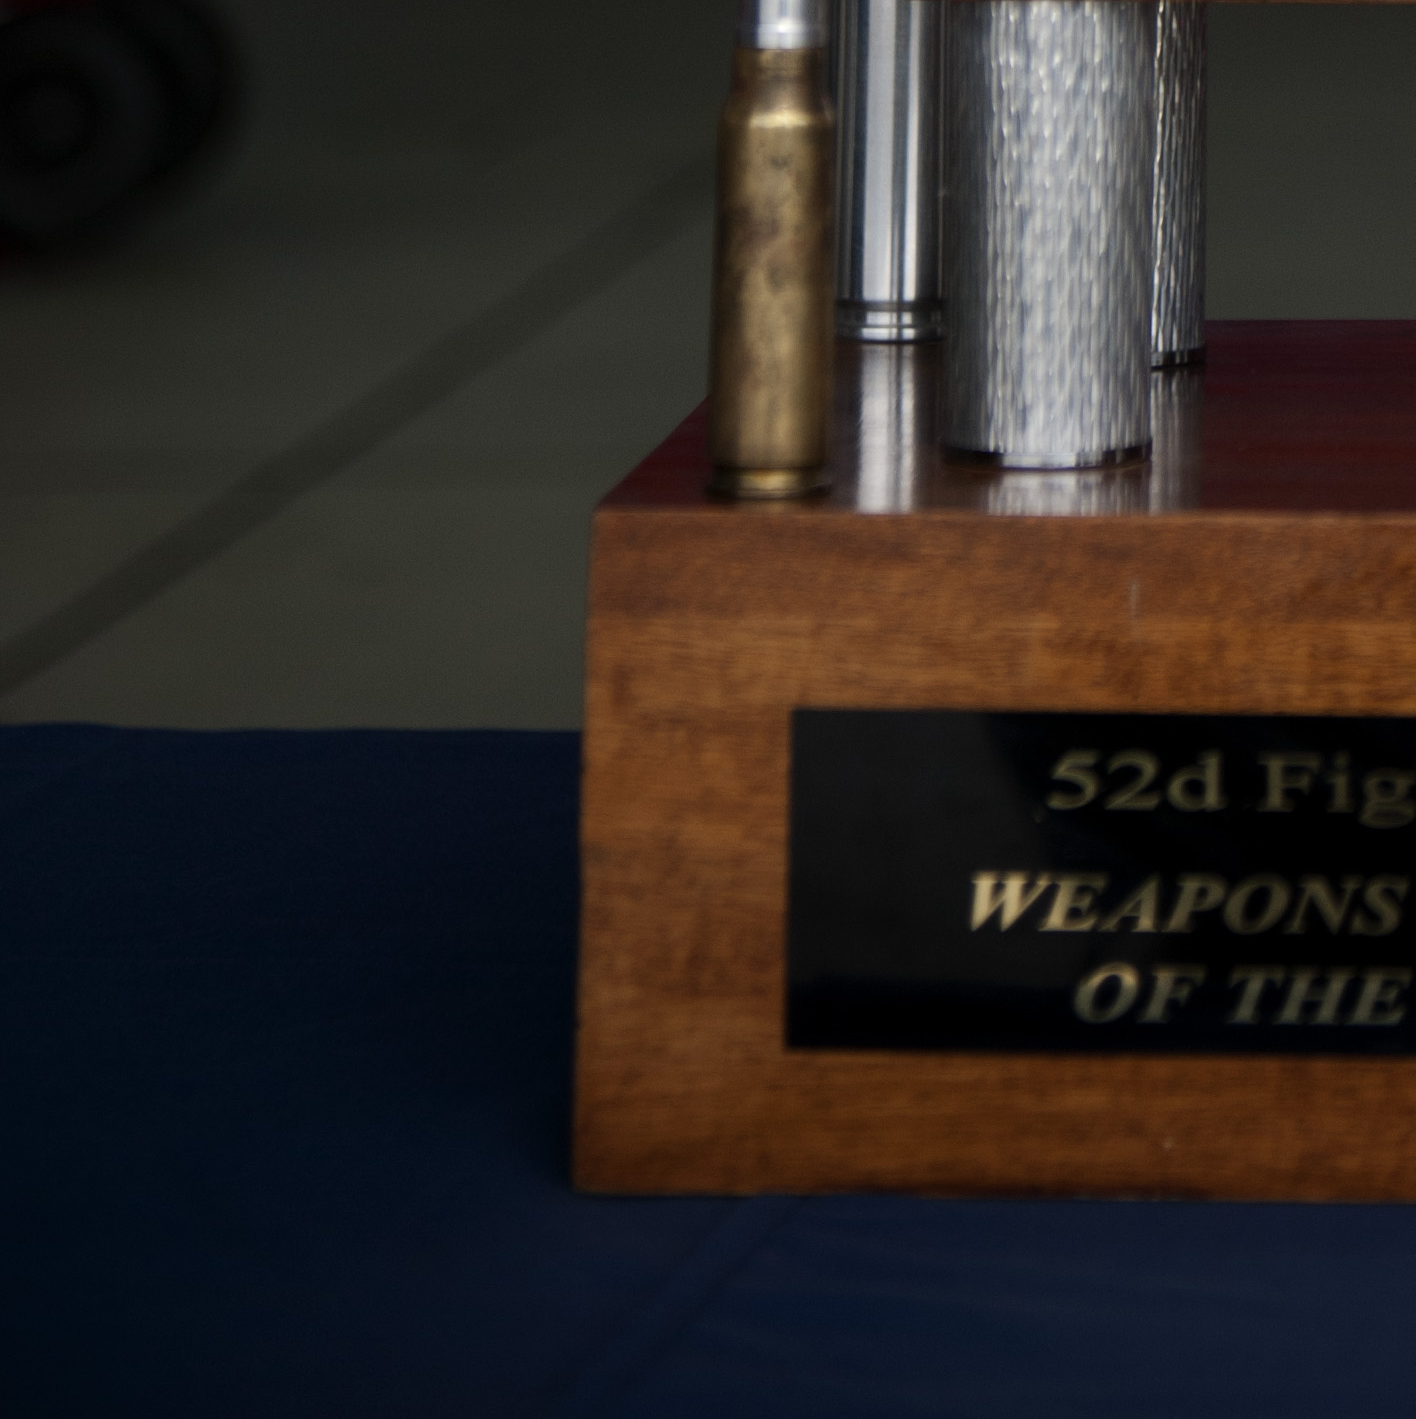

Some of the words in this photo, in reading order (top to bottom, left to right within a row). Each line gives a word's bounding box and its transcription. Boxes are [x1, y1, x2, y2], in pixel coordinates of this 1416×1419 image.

[1047, 751, 1223, 811] 52d
[966, 869, 1407, 933] WEAPONS
[1074, 960, 1203, 1021] OF
[1231, 968, 1410, 1024] THE
